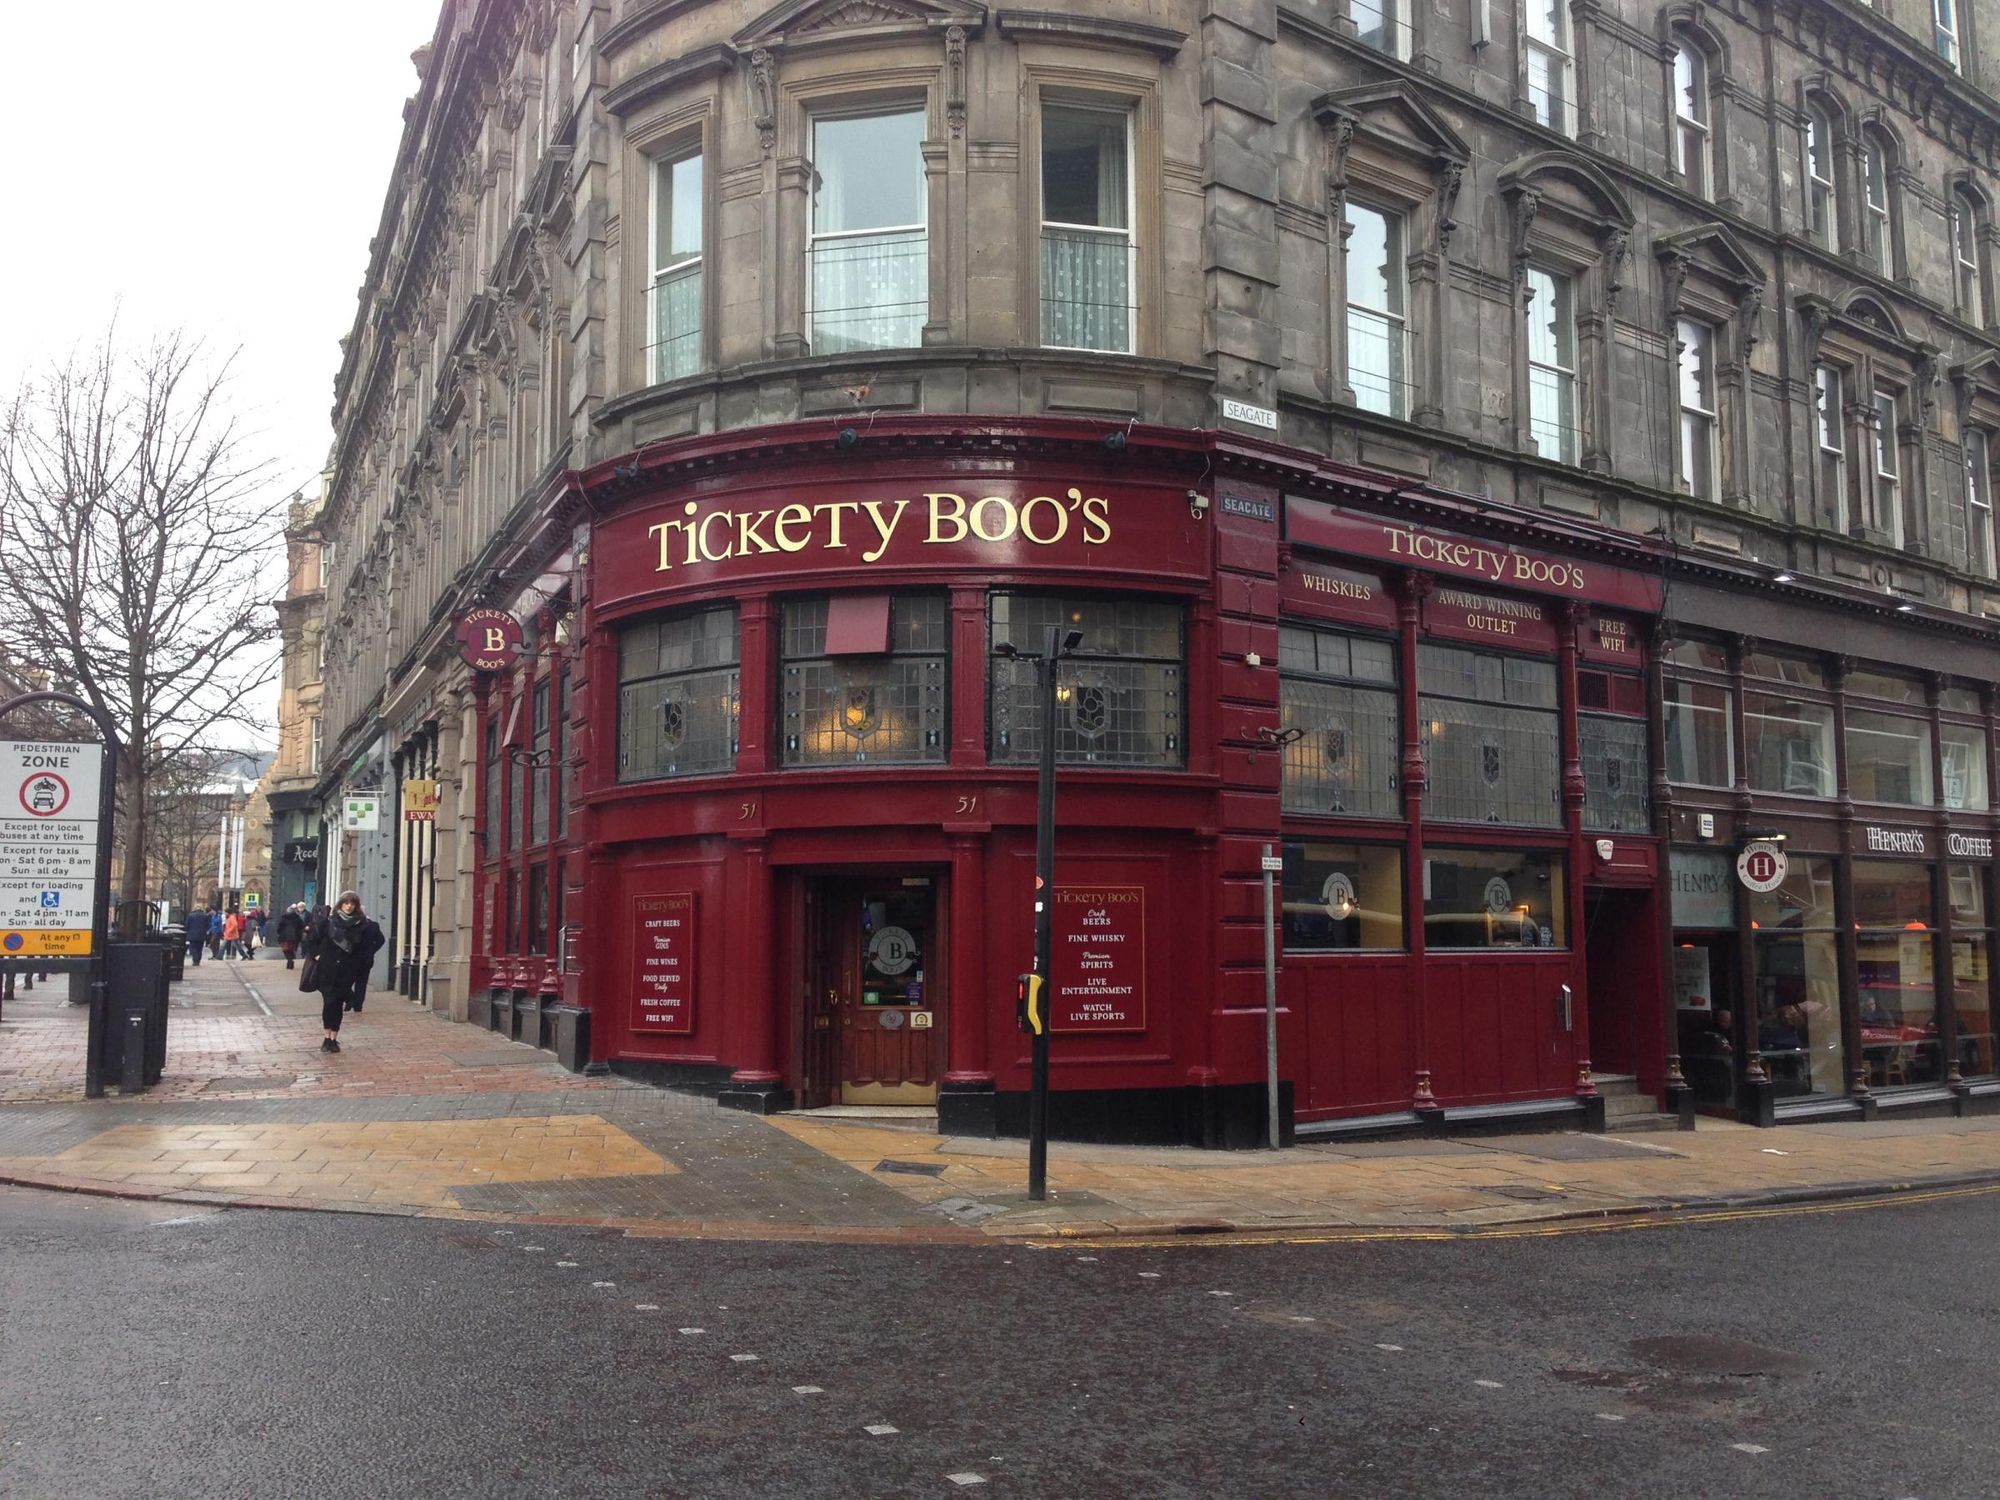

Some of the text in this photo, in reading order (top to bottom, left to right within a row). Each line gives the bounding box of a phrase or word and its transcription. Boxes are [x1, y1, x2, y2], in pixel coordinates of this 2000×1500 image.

[1227, 402, 1273, 426] SEAGATE
[1223, 497, 1271, 518] SEAGATE
[922, 488, 1111, 545] BOO'S
[1513, 553, 1585, 590] BOO'S
[1302, 573, 1371, 600] WHISKIES
[1438, 590, 1542, 621] AWARD WINNING
[464, 609, 515, 625] TICKETY
[1467, 613, 1517, 635] OUTLET
[1599, 618, 1626, 635] FREE
[483, 627, 506, 652] B
[1600, 636, 1625, 653] WIFI
[475, 657, 506, 669] BOO'S
[13, 744, 80, 754] PEDESTRIAN
[22, 755, 70, 768] ZONE
[955, 795, 977, 814] 51
[410, 811, 435, 820] EWM
[738, 802, 757, 821] 51
[4, 823, 81, 832] Except for local
[1866, 826, 1925, 854] HENRY'S
[1947, 833, 1993, 857] COFFEE
[3, 846, 36, 855] Except
[56, 847, 79, 855] taxis
[18, 856, 35, 864] Sat
[11, 866, 30, 874] Sun
[37, 867, 49, 875] all
[52, 868, 69, 876] day
[1751, 857, 1772, 876] H
[31, 881, 45, 889] for
[48, 881, 83, 890] loading
[18, 895, 37, 903] and
[14, 909, 31, 917] Sat
[8, 918, 27, 926] Sun
[34, 918, 46, 926] all
[49, 919, 66, 927] day
[645, 919, 681, 928] CRAFT BEERS
[1082, 918, 1111, 926] BEERS
[54, 934, 71, 942] any
[1067, 934, 1126, 943] FINE WHISKY
[888, 942, 903, 959] B
[646, 958, 678, 966] FINE WINES
[1080, 961, 1114, 969] SPIRITS
[642, 974, 681, 982] FOOD SERVED
[1087, 977, 1107, 986] LIVE
[1061, 986, 1133, 995] ENTERTAINMENT
[640, 998, 681, 1007] FRESH COFFEE
[1082, 1003, 1112, 1011] WATCH
[645, 1014, 661, 1022] FREE
[1070, 1012, 1125, 1021] LIVE SPORTS
